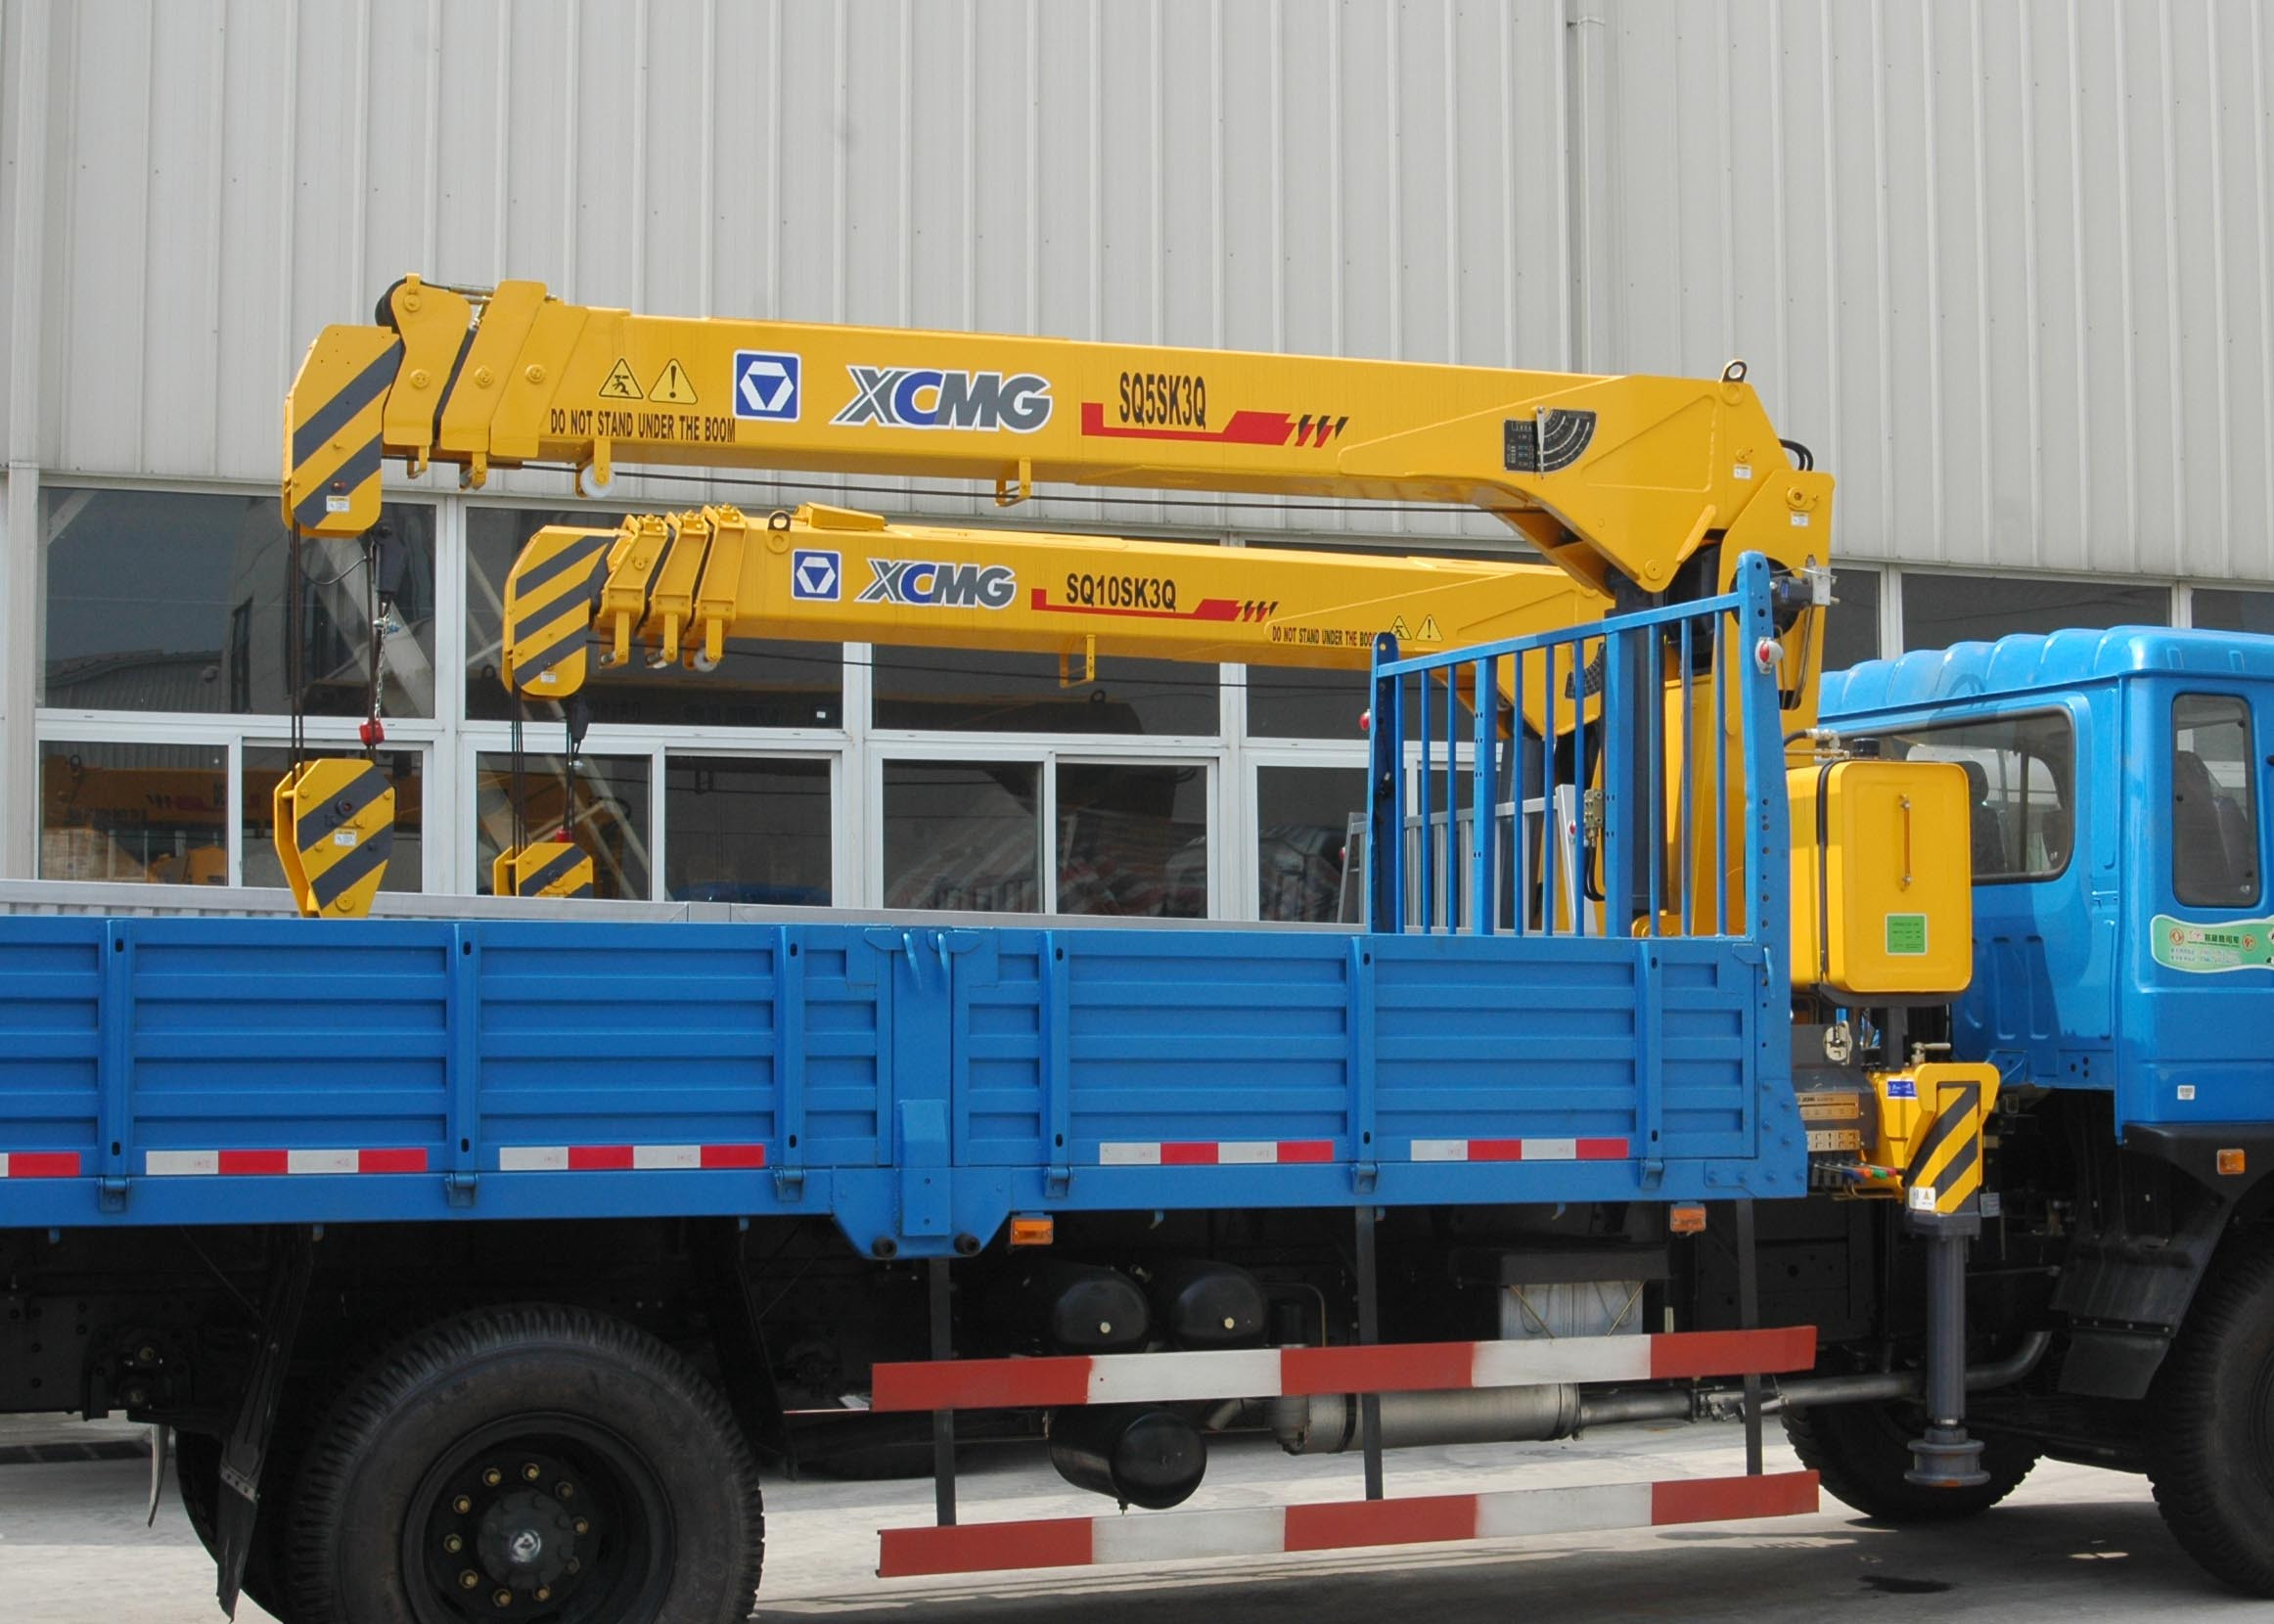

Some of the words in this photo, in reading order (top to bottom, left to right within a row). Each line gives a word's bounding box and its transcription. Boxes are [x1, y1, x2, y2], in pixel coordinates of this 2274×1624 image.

[830, 365, 1053, 433] XCMG
[1119, 371, 1206, 430] SQ5SK3Q
[551, 408, 566, 434] DO
[570, 410, 593, 435] NOT
[598, 411, 633, 437] STAND
[638, 413, 674, 439] UNDER
[679, 415, 700, 440] THE
[705, 417, 736, 443] BOOM
[854, 557, 1017, 610] XCMG
[1067, 572, 1176, 612] SQ10SK3Q
[1272, 626, 1281, 642] DO
[1284, 627, 1296, 643] NOT
[1298, 627, 1320, 644] STAND
[1322, 629, 1343, 646] UNDER
[1345, 630, 1357, 647] THE
[1359, 631, 1376, 648] BOO
